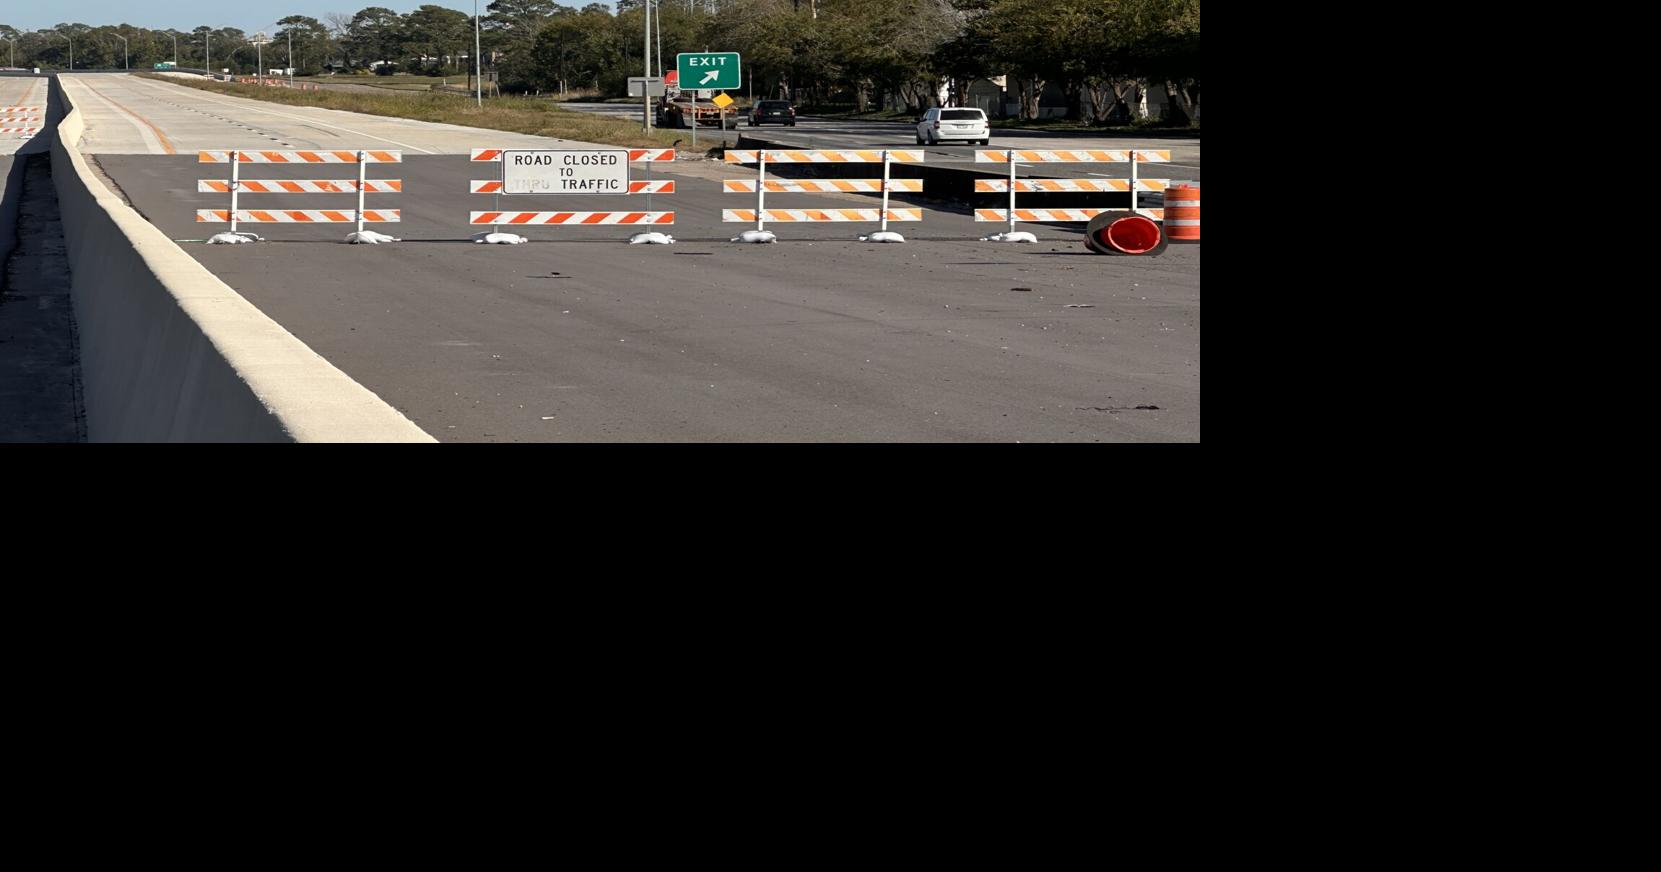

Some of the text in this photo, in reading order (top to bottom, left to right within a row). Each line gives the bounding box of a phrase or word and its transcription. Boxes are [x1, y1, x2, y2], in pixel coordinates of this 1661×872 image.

[689, 56, 727, 66] EXIT
[515, 155, 617, 165] ROAD CLOSED
[559, 168, 573, 177] TO
[561, 179, 618, 189] TRAFFIC
